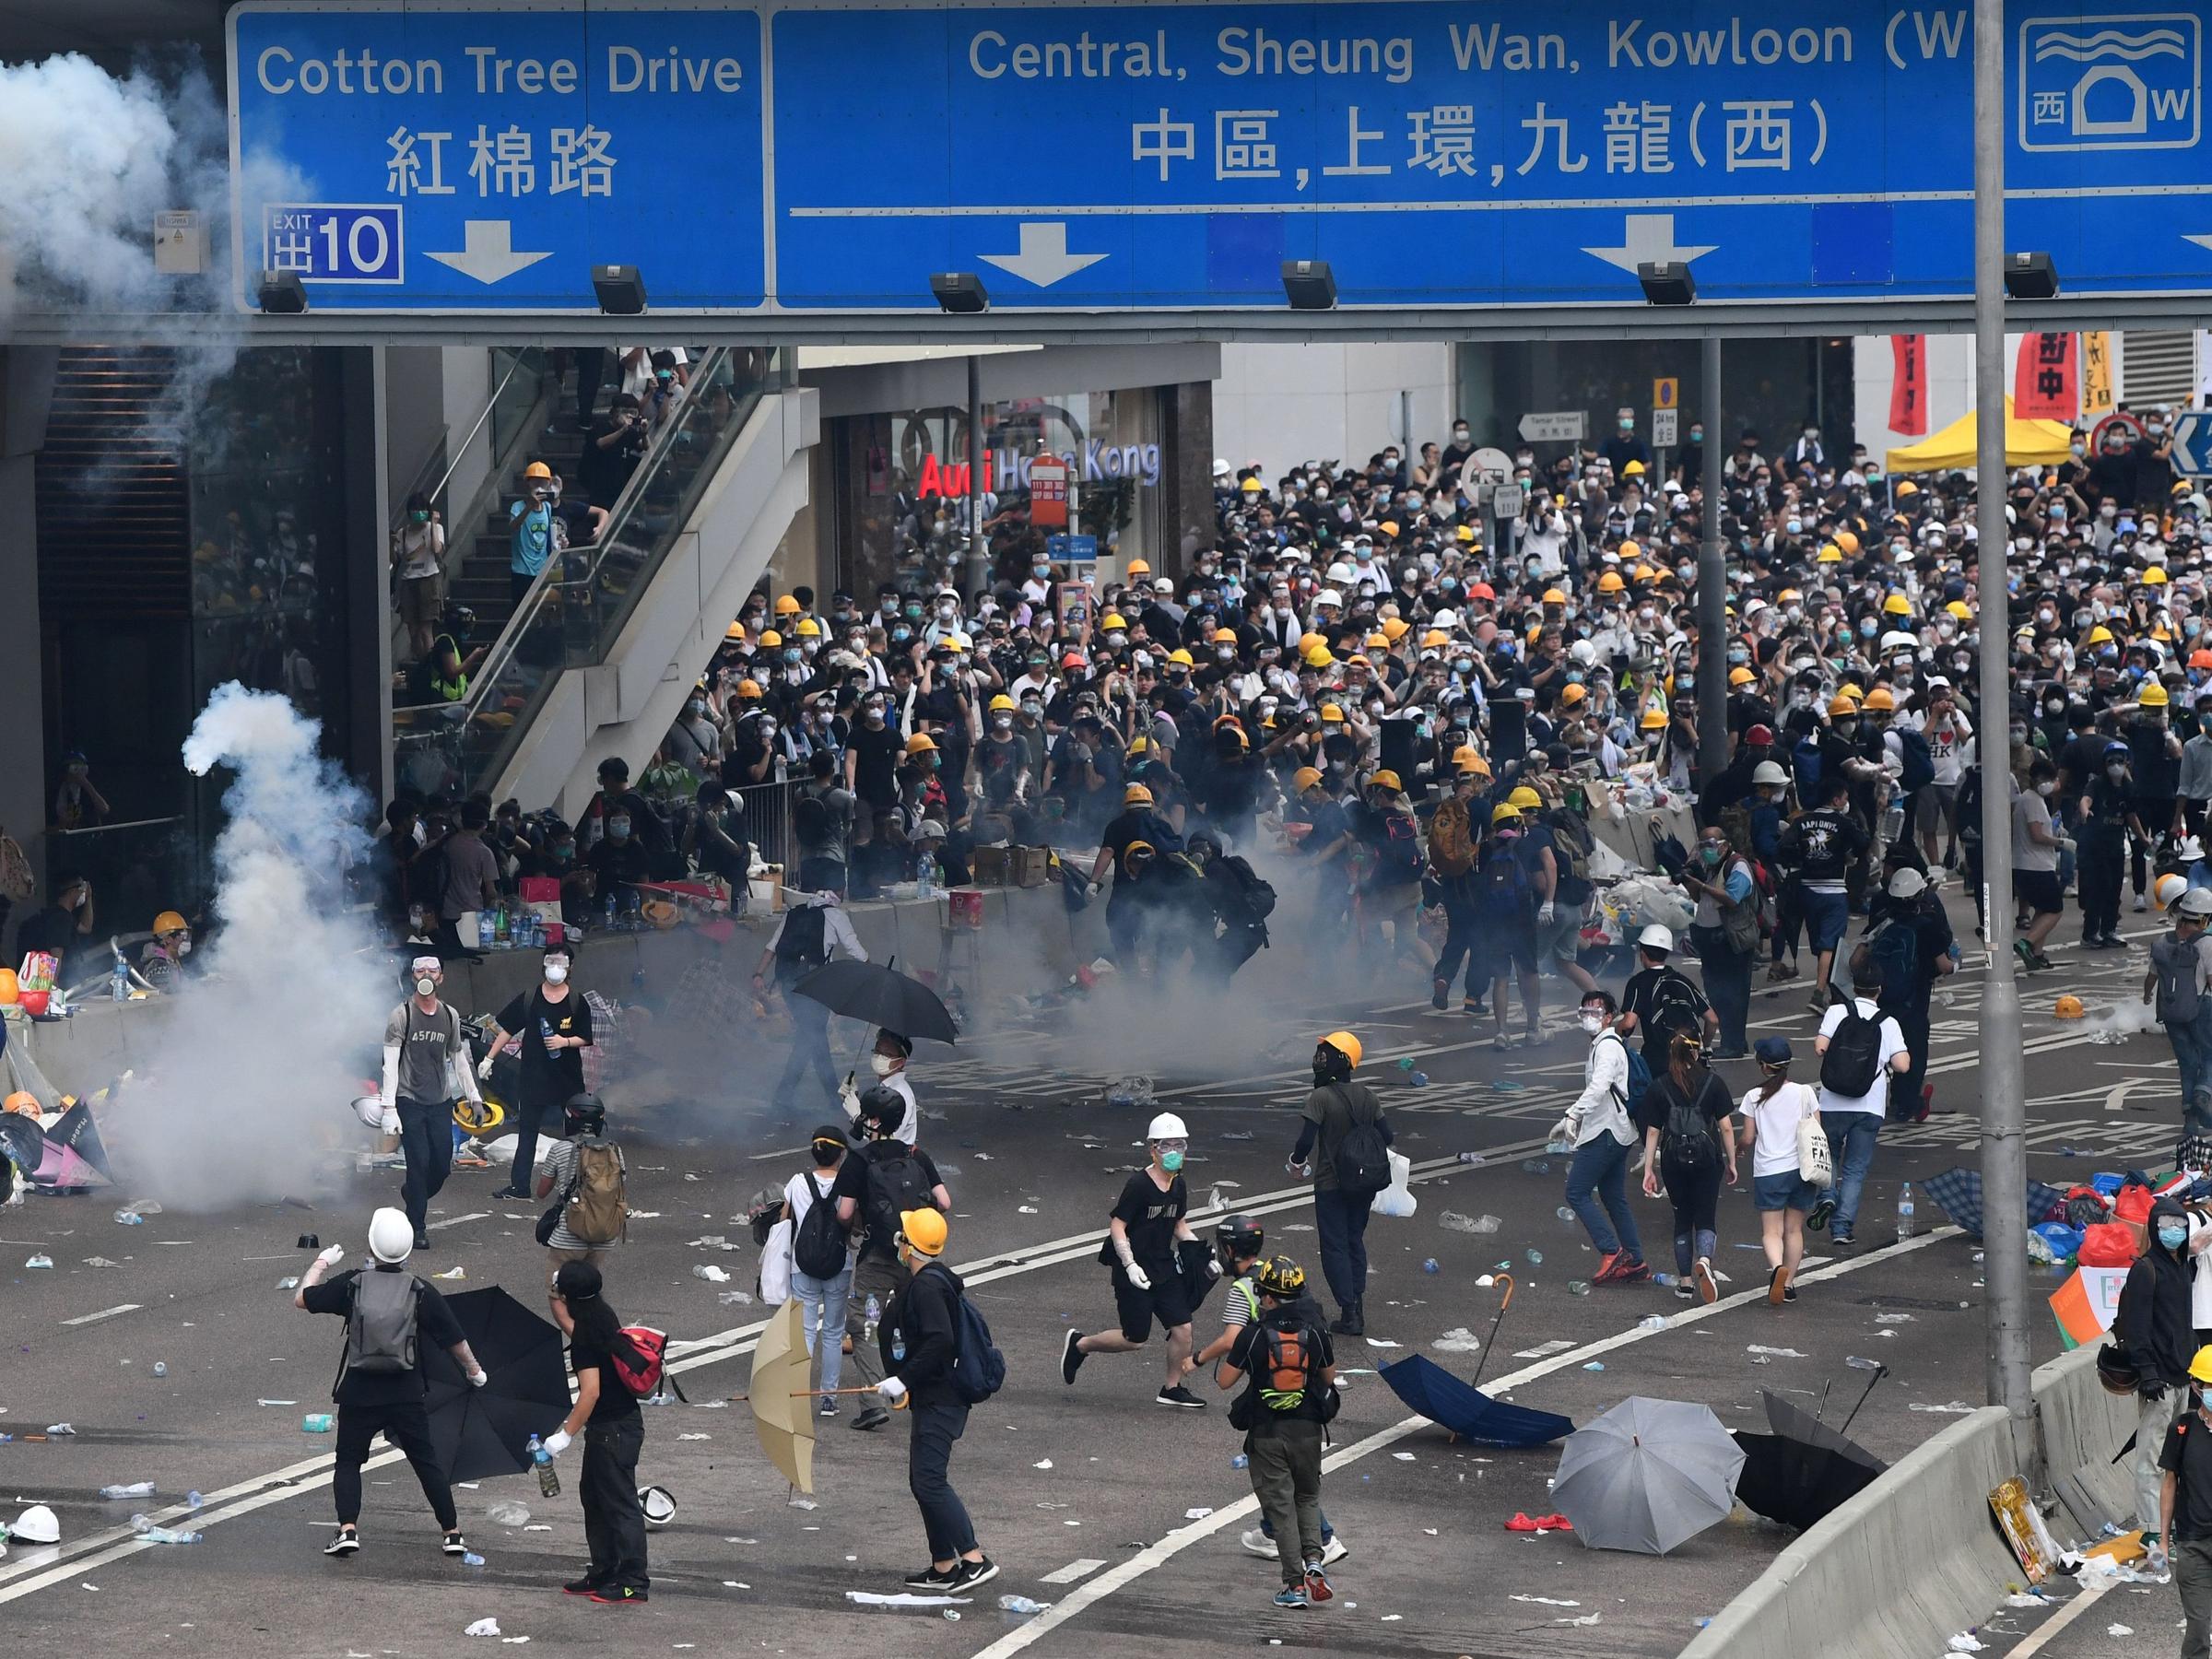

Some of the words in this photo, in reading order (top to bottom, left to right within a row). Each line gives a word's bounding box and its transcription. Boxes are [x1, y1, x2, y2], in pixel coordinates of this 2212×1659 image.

[257, 46, 442, 94] Cotton
[465, 46, 578, 94] Tree
[608, 45, 742, 93] Drive
[969, 29, 1187, 81] Central,
[1217, 28, 1413, 83] Sheung
[1448, 24, 1580, 74] Wan,
[1608, 17, 1852, 69] Kowloon
[1885, 10, 1975, 71] (W
[2033, 92, 2066, 124] 西
[2151, 89, 2190, 121] W
[386, 124, 617, 196] 紅棉路
[1133, 99, 1826, 191] 中區,上環,九龍(西)
[273, 215, 312, 230] EXIT
[320, 216, 389, 273] 10
[275, 235, 313, 274] 出
[1085, 439, 1160, 487] Kong
[1984, 953, 1991, 967] A
[412, 1030, 446, 1043] 45rpm
